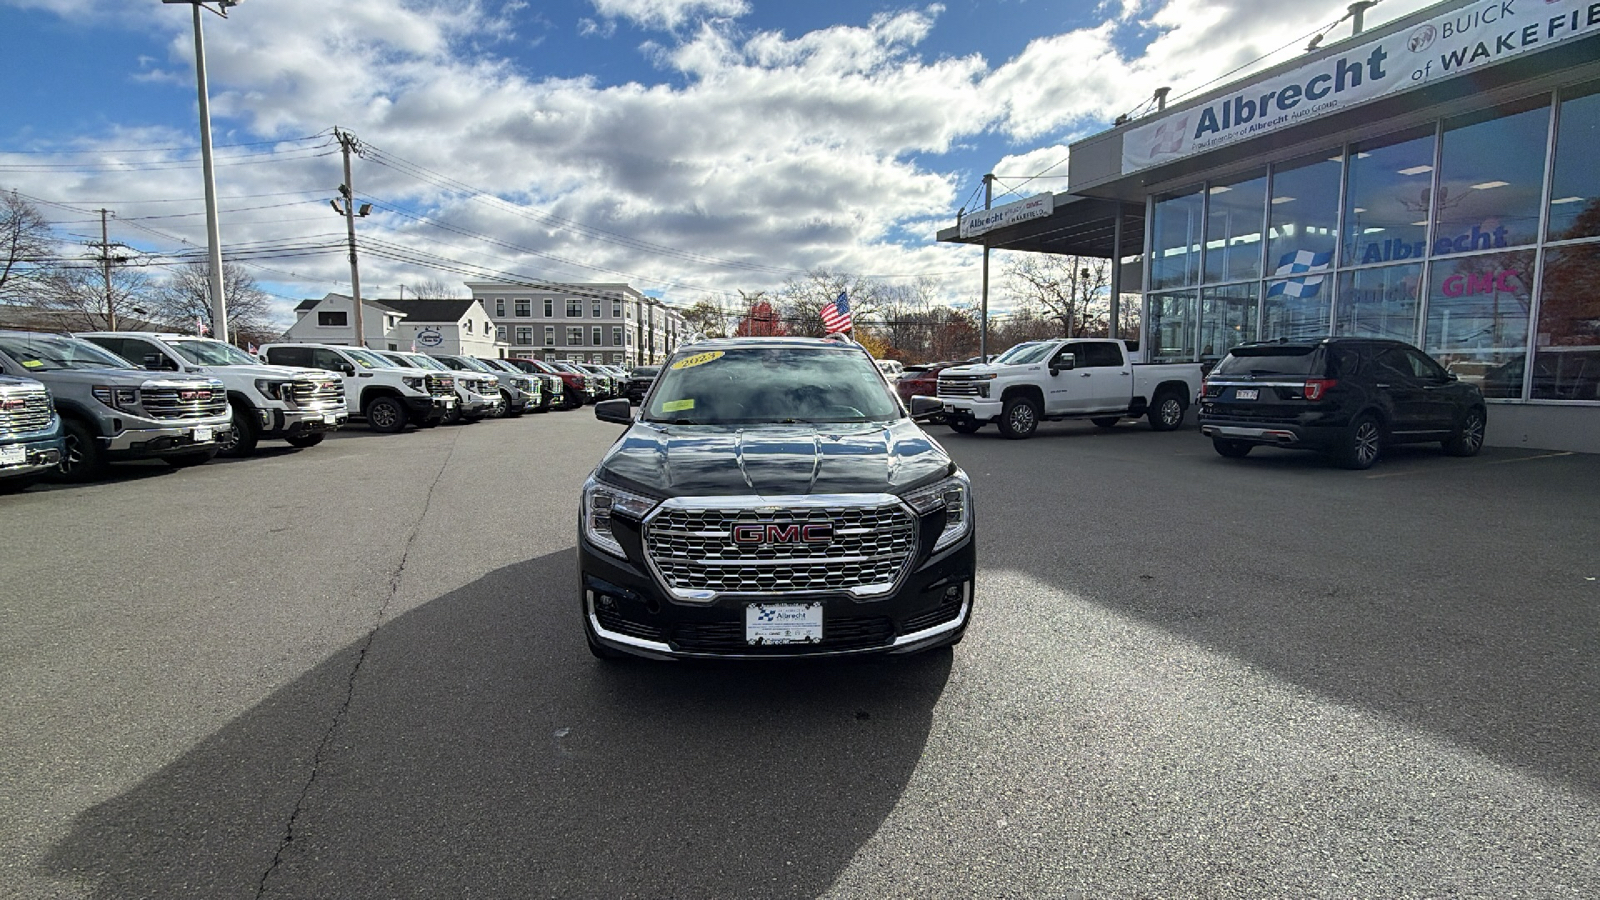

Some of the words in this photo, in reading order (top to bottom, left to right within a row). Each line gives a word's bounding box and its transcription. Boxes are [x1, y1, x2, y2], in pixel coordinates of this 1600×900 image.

[1442, 0, 1515, 39] BUICK
[1411, 60, 1432, 81] of
[1193, 45, 1387, 140] Albrecht
[1191, 138, 1211, 150] Proud
[1211, 130, 1239, 145] member
[1248, 114, 1289, 133] Albrecht
[1291, 109, 1310, 120] Auto
[1311, 100, 1338, 113] Group
[970, 212, 1003, 229] Albrecht
[1361, 225, 1509, 265] Albrecht
[1442, 269, 1519, 298] GMC
[734, 524, 832, 543] GMC
